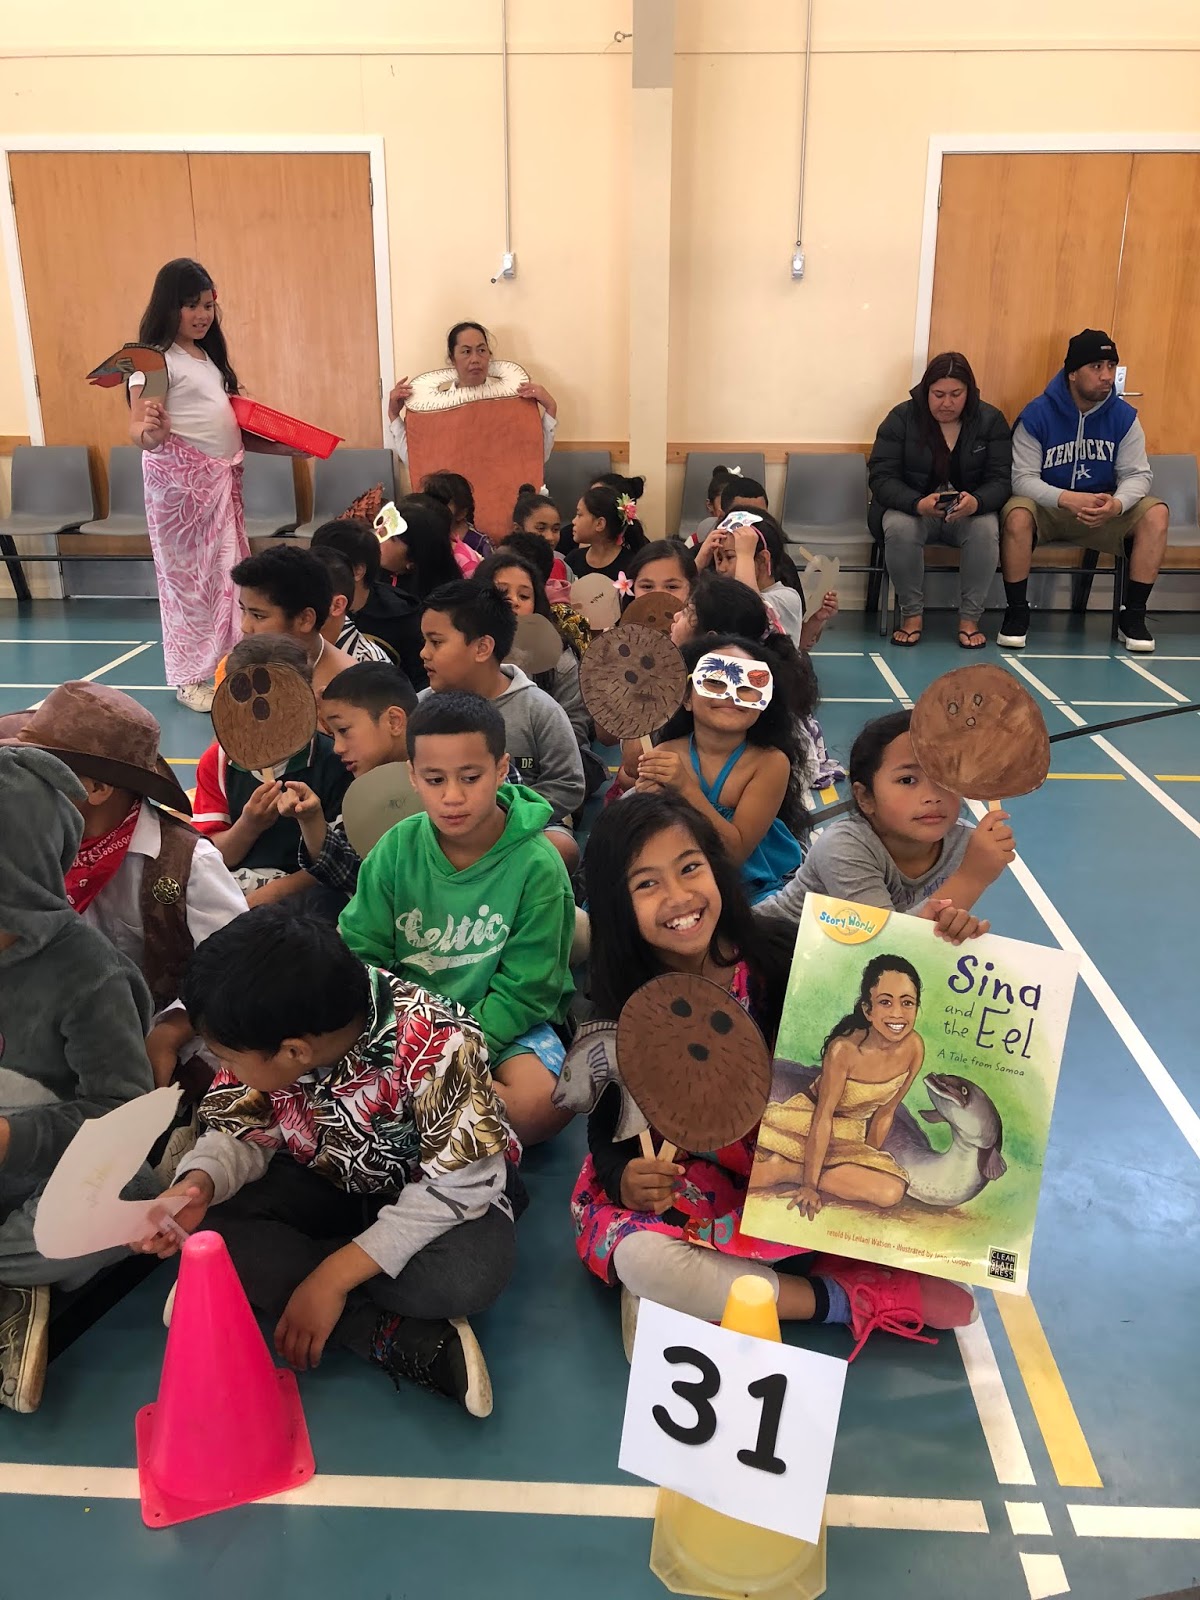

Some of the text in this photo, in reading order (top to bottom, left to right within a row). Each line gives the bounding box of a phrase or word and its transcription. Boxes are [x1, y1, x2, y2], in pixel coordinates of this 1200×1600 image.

[396, 904, 510, 953] Celtic
[820, 911, 876, 934] Story World
[948, 955, 1041, 1011] Sina
[945, 1002, 975, 1018] and
[944, 1006, 1034, 1059] the Eel
[937, 1048, 1025, 1077] A Tale from Samoa
[827, 1230, 844, 1239] retold
[844, 1232, 851, 1242] by
[871, 1238, 892, 1249] Watson
[896, 1243, 926, 1257] illustrated
[926, 1250, 934, 1260] by
[991, 1251, 1015, 1263] CLEAN
[990, 1268, 1013, 1279] PRESS
[991, 1260, 1014, 1271] SLATE
[651, 1345, 788, 1475] 31
